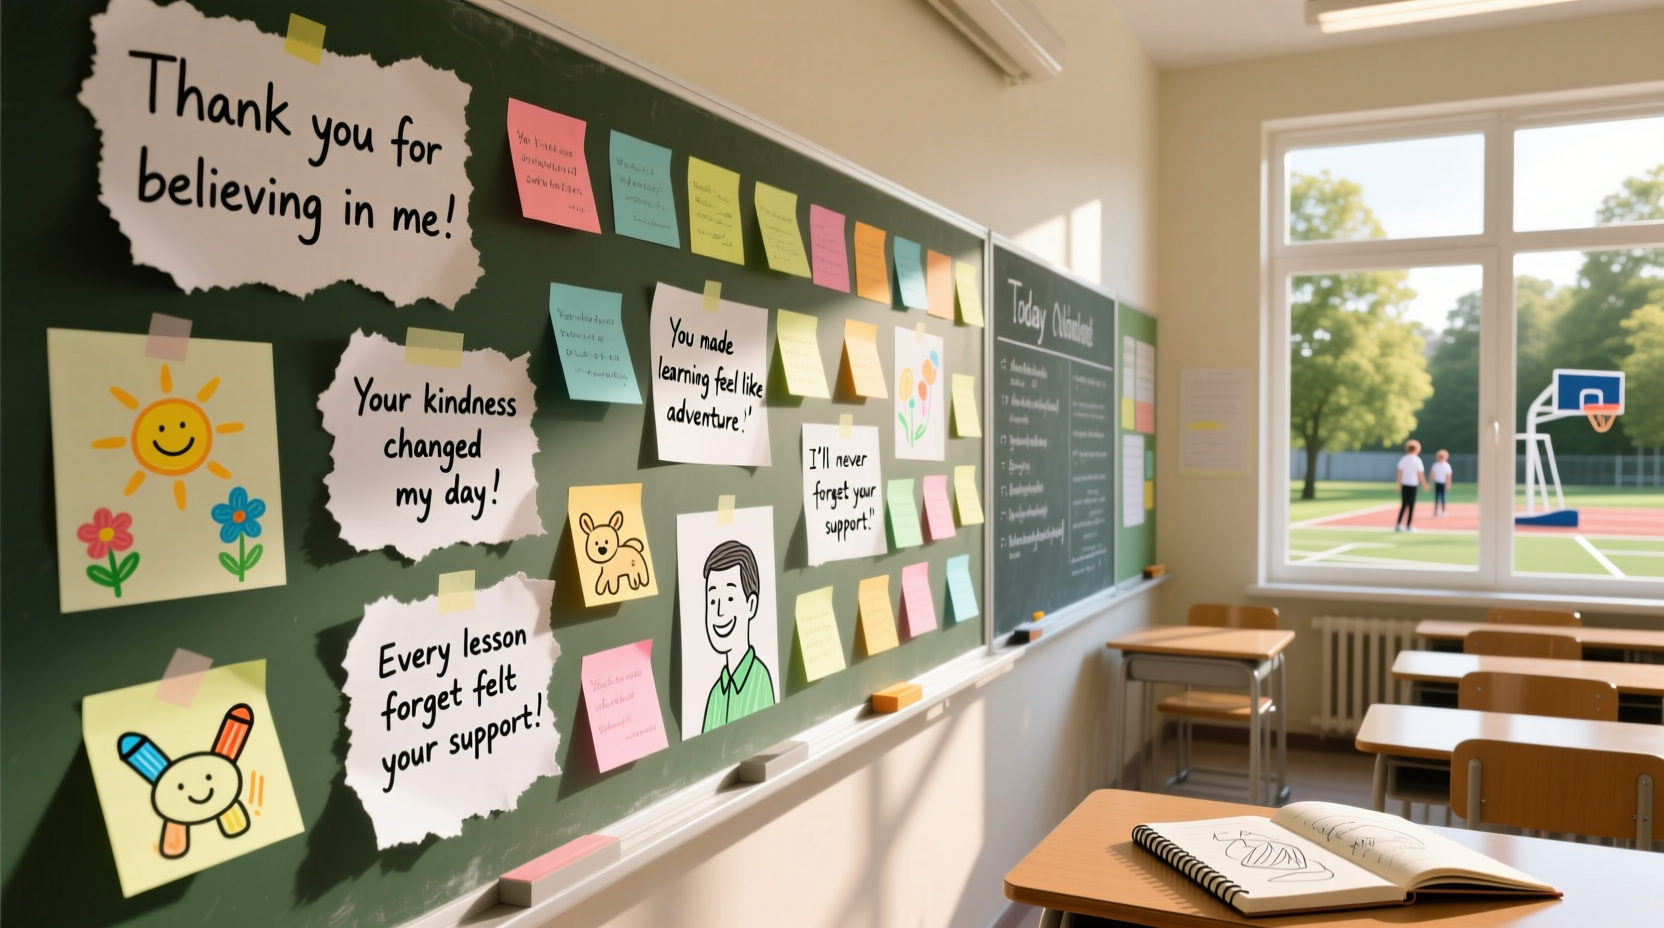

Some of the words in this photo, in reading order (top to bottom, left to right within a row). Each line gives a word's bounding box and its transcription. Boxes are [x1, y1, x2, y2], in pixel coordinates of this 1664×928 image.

[128, 50, 292, 136] Thank
[307, 114, 374, 168] you
[390, 115, 443, 168] for
[138, 145, 322, 246] believing
[344, 188, 374, 229] in
[392, 193, 456, 240] me!
[669, 316, 695, 349] You
[699, 329, 735, 356] made
[1008, 278, 1047, 345] Today
[353, 376, 412, 417] Your
[423, 382, 518, 417] kindness
[658, 355, 710, 400] learning
[714, 365, 739, 396] feel
[742, 371, 763, 399] like
[383, 426, 482, 474] changed
[808, 446, 830, 470] I'll
[835, 454, 868, 468] never
[396, 487, 433, 524] my
[444, 468, 500, 521] day!
[812, 480, 850, 510] forget
[852, 486, 877, 509] your
[378, 642, 451, 679] Every
[463, 627, 527, 658] lesson
[380, 678, 463, 732] forget
[472, 663, 518, 707] felt
[381, 740, 439, 794] your
[449, 692, 543, 760] support!
